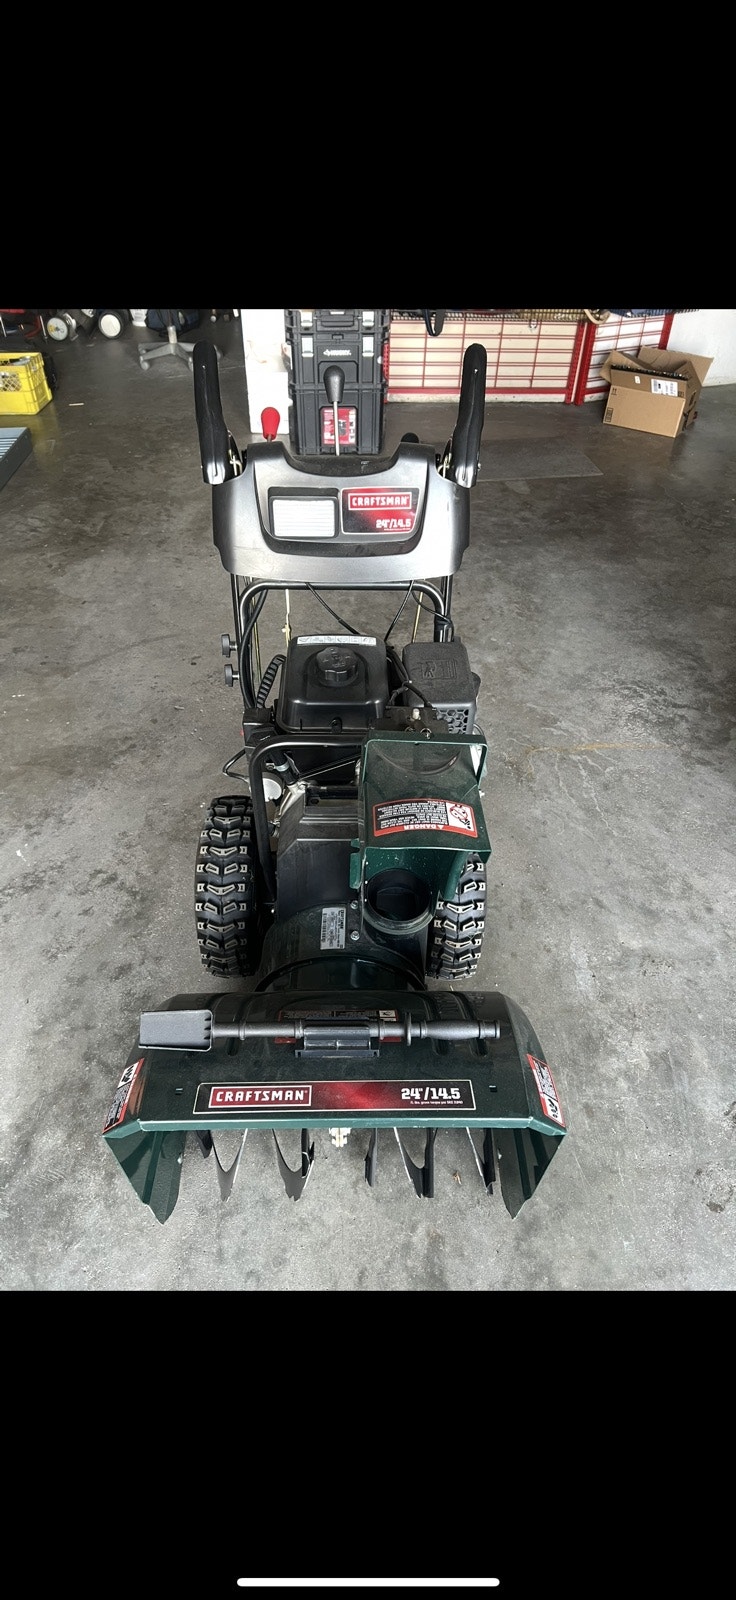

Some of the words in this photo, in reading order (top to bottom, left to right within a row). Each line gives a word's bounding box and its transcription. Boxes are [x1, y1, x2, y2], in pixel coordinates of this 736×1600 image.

[351, 495, 408, 507] CRAFTSMAN
[216, 1089, 304, 1102] CRAFTSMAN
[401, 1086, 461, 1100] 24"/14.5
